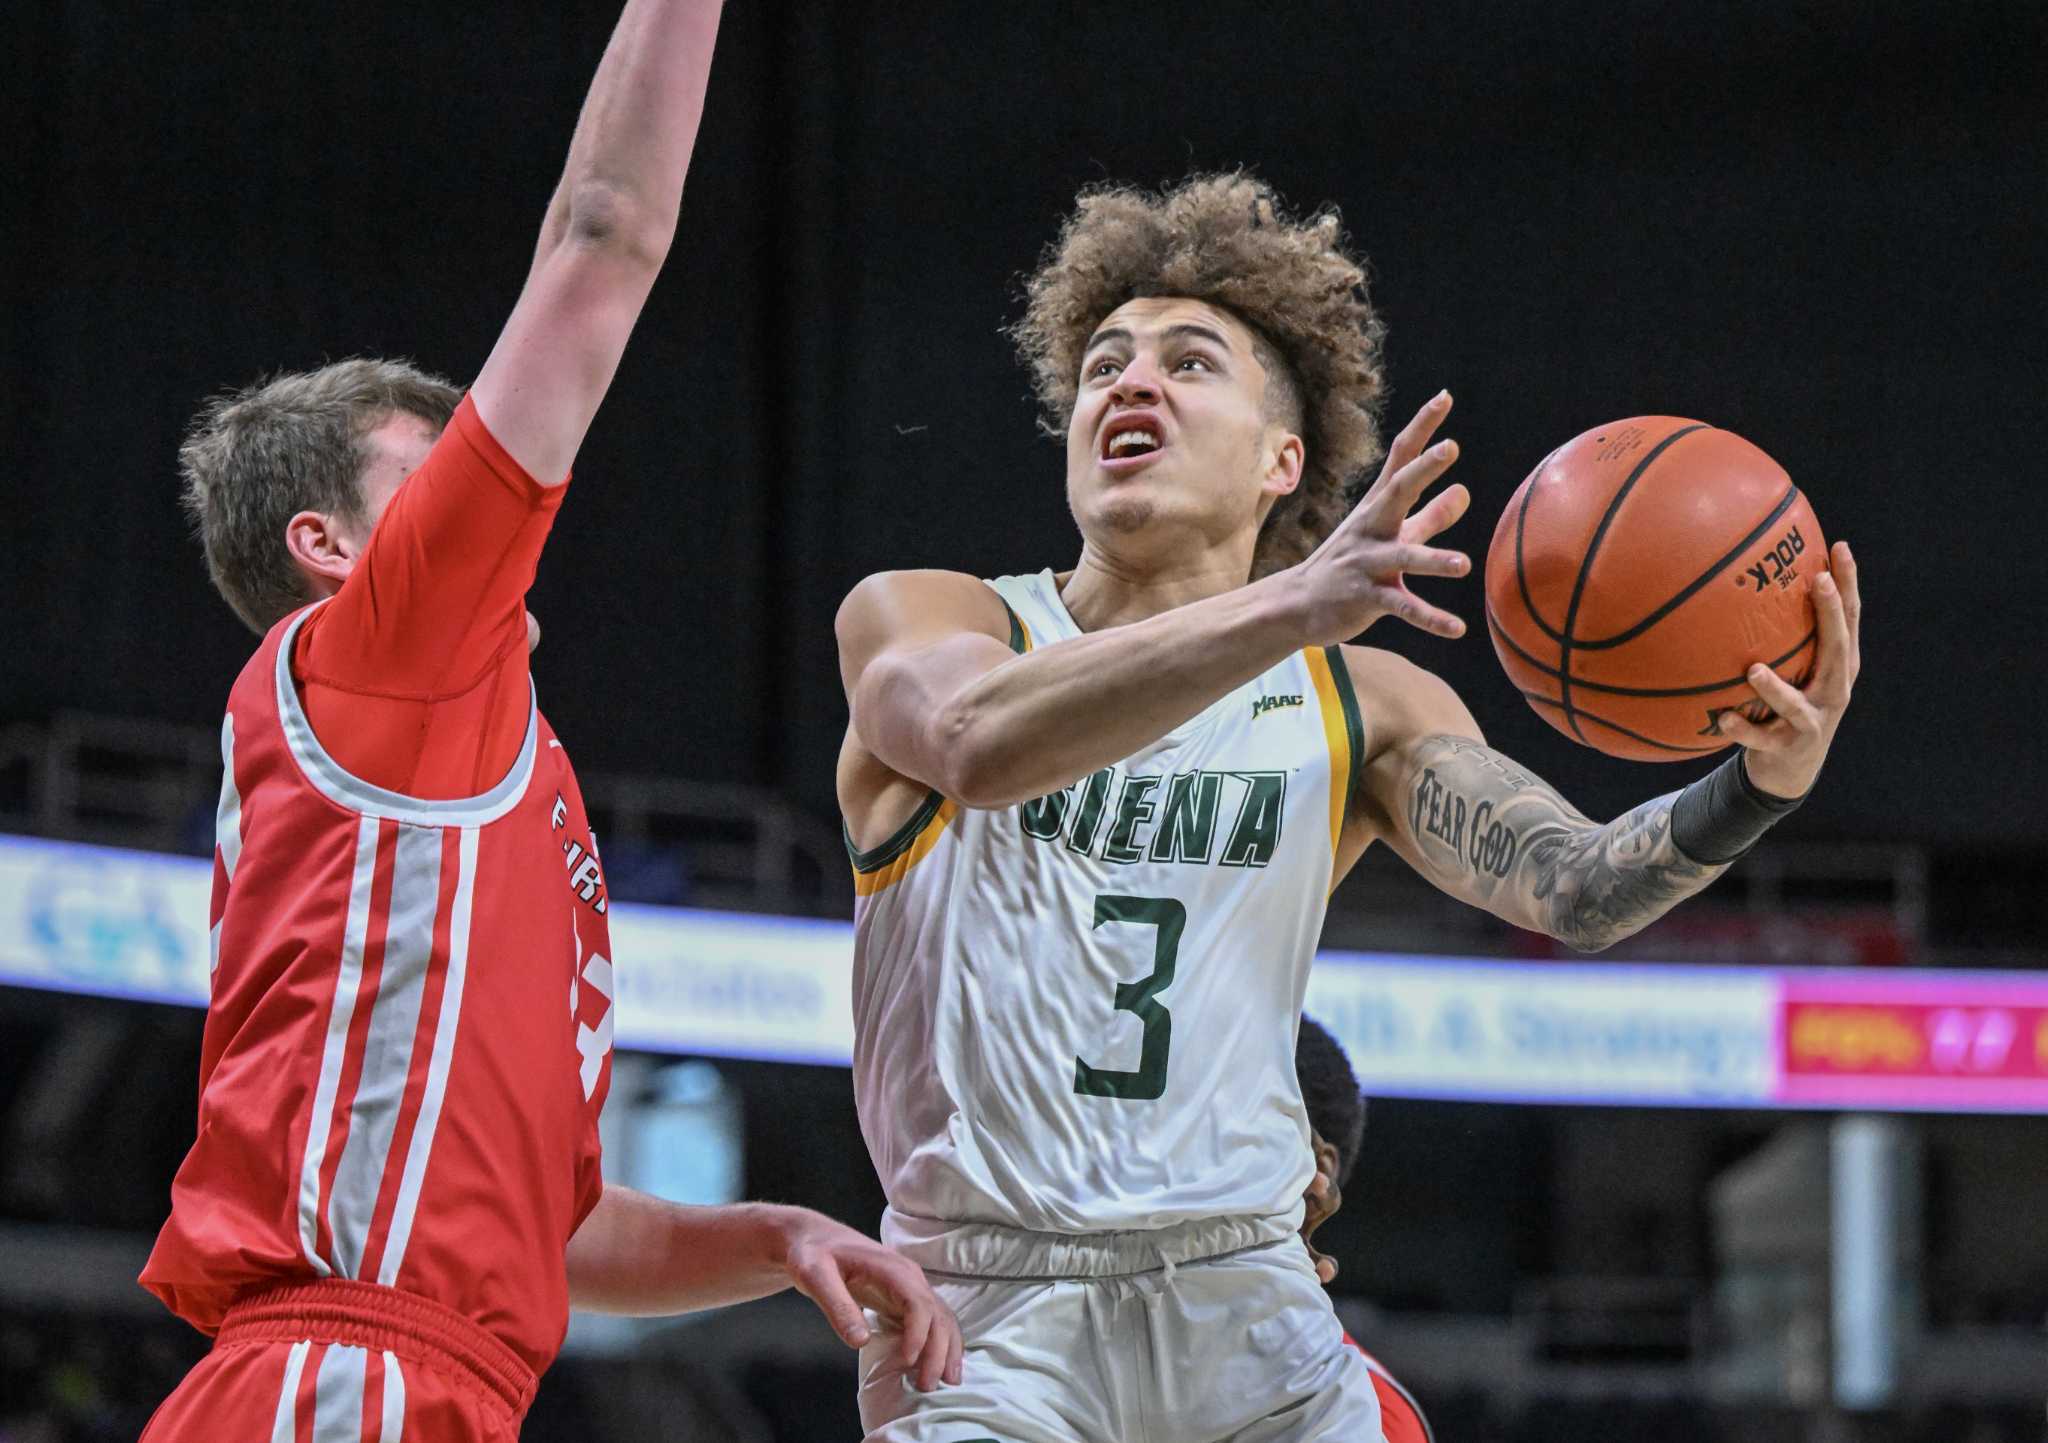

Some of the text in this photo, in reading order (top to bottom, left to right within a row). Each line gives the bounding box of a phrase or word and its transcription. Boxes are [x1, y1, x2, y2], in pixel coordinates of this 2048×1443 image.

[1746, 525, 1805, 592] ROCK
[1779, 566, 1799, 590] THE
[1252, 694, 1303, 720] MAAC
[1415, 768, 1516, 878] FEAR GOD
[1073, 894, 1187, 1100] 3
